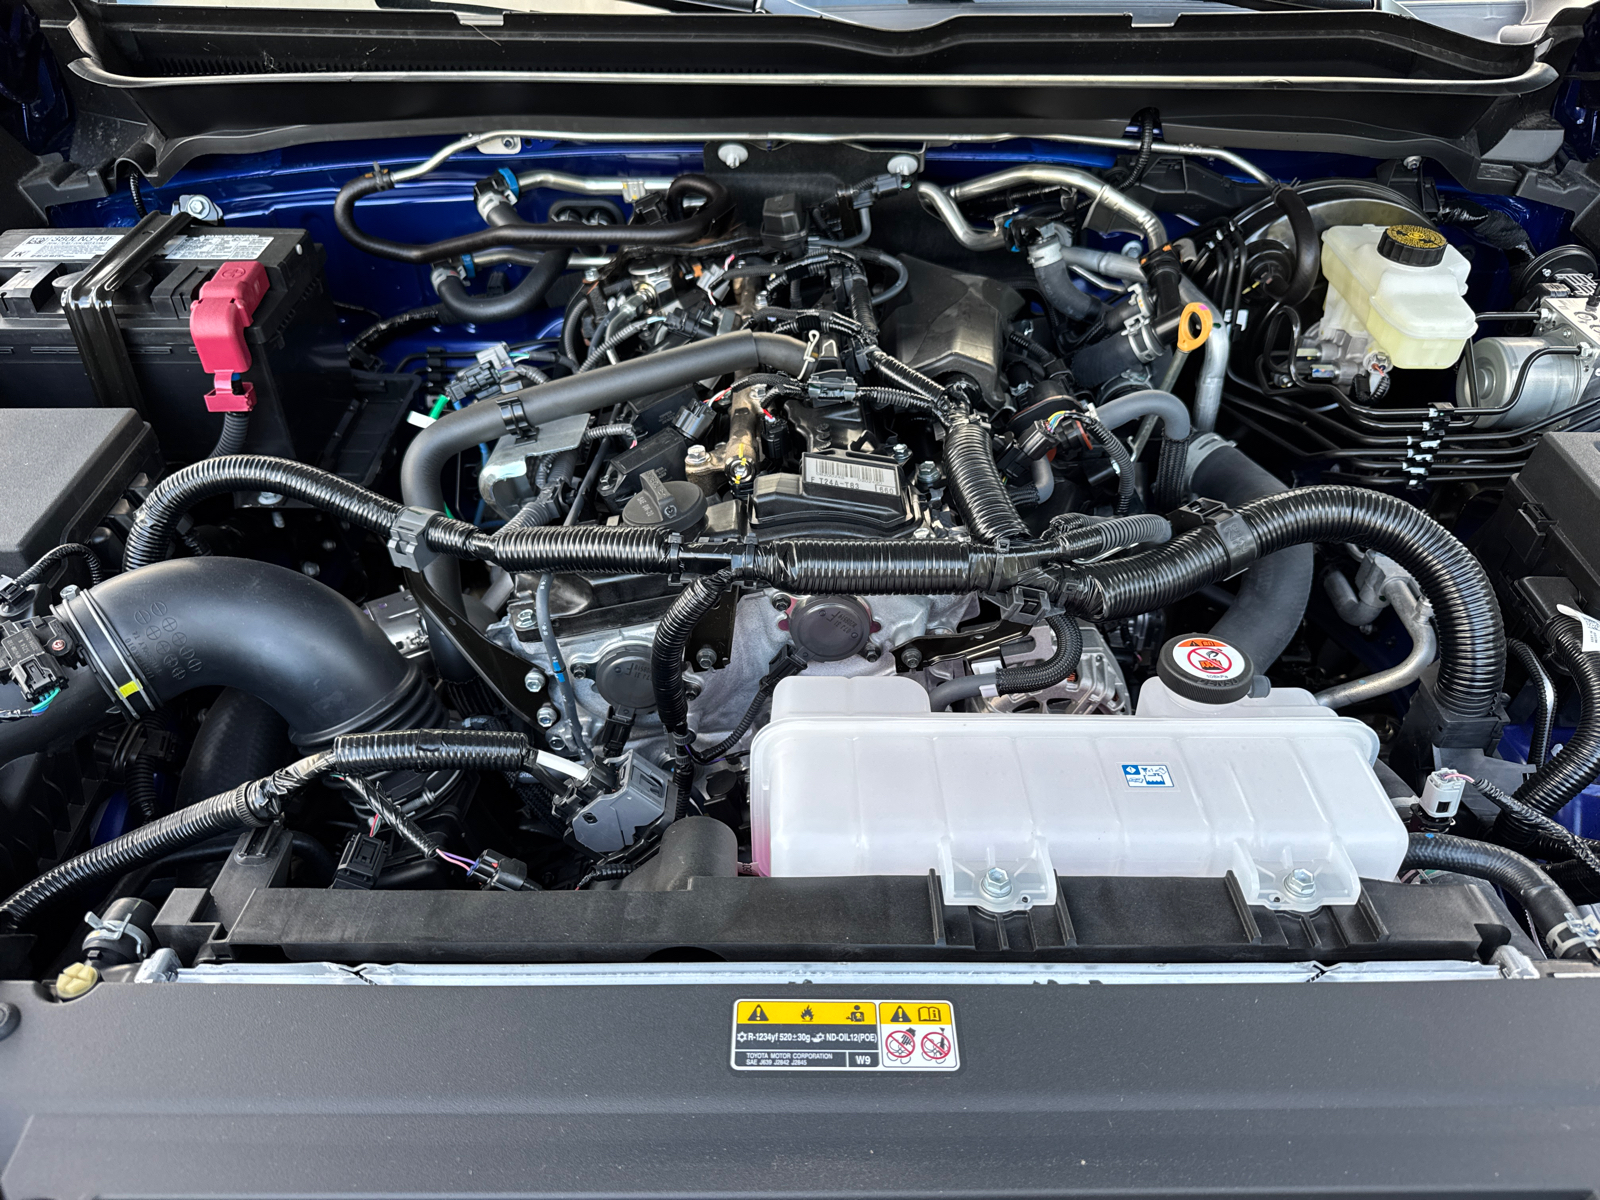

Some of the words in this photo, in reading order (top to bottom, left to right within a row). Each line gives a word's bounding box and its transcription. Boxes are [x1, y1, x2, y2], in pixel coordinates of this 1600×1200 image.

[747, 1032, 779, 1043] R-1234yf
[779, 1032, 811, 1043] 520±30g
[826, 1032, 878, 1043] ND-OIL12(POE)
[792, 1052, 833, 1060] CORPORATION
[855, 1055, 871, 1065] W9
